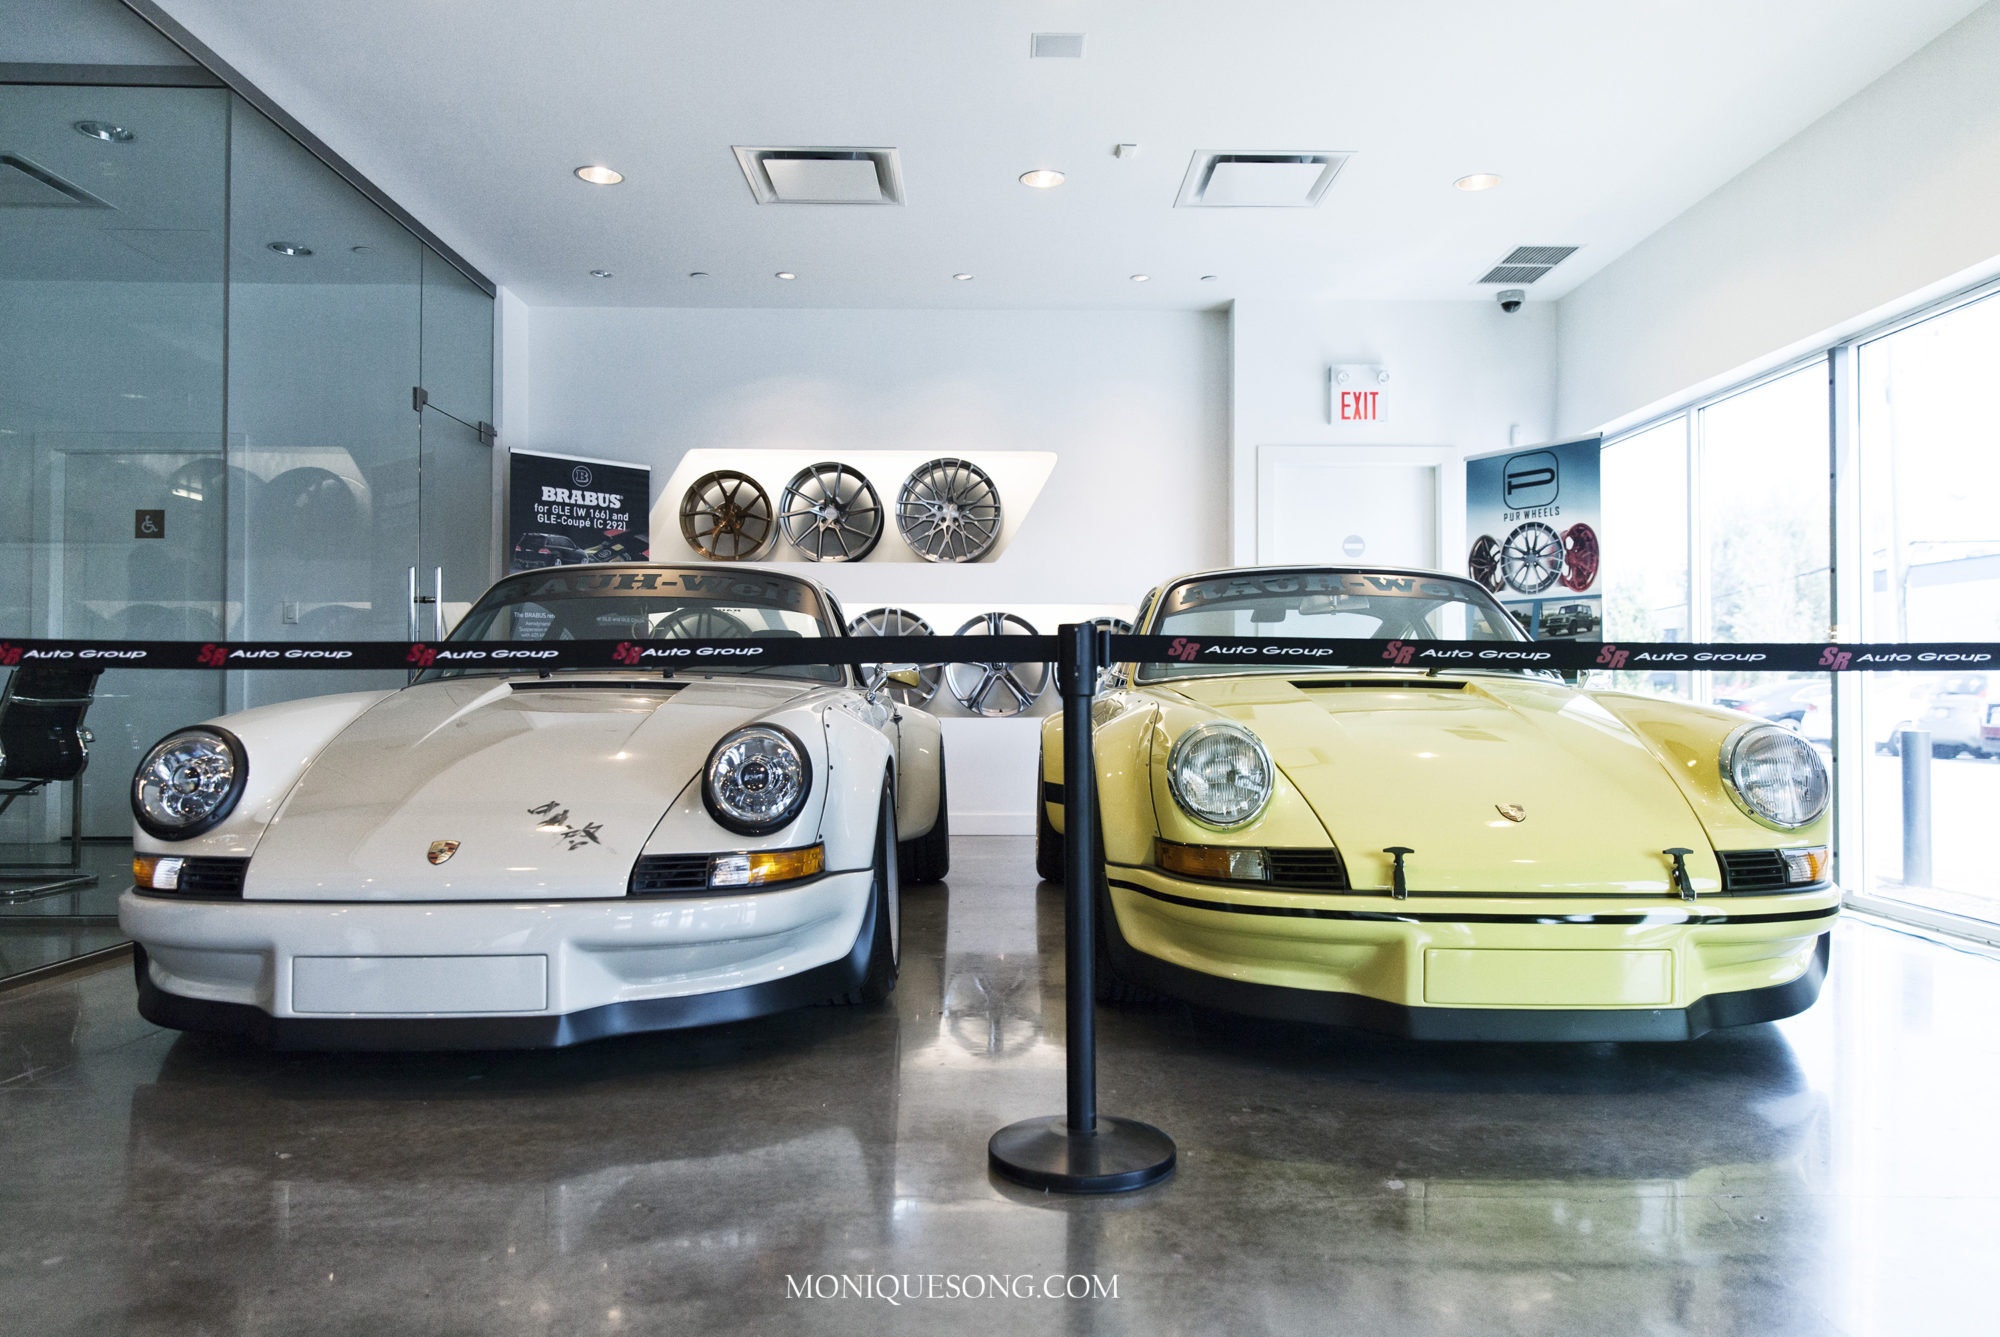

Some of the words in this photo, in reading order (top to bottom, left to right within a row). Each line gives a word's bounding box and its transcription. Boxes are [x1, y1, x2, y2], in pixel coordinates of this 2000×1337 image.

[1341, 391, 1379, 420] EXIT
[541, 485, 621, 509] BRABUS
[534, 503, 549, 513] for
[552, 505, 571, 516] GLE
[573, 506, 587, 518] (W
[590, 509, 610, 520] 166)
[612, 512, 629, 521] and
[1503, 511, 1520, 522] PUR
[1524, 505, 1560, 520] WHEELS
[537, 513, 591, 529] GLE-Coupé
[593, 518, 604, 529] (C
[606, 520, 626, 531] 292)
[22, 649, 74, 659] Auto
[78, 649, 147, 660] Group
[229, 649, 280, 659] Auto
[284, 649, 353, 660] Group
[436, 649, 487, 659] Auto
[491, 649, 559, 659] Group
[640, 647, 691, 657] Auto
[696, 646, 763, 657] Group
[1167, 637, 1200, 661] SR
[1203, 645, 1258, 655] Auto
[1262, 645, 1334, 657] Group
[1381, 640, 1416, 665] SR
[1419, 648, 1474, 658] Auto
[1478, 649, 1552, 661] Group
[1595, 645, 1630, 669] SR
[1633, 652, 1689, 661] Auto
[1693, 652, 1767, 662] Group
[1818, 646, 1852, 671] SR
[1856, 652, 1912, 662] Auto
[1916, 652, 1992, 663] Group
